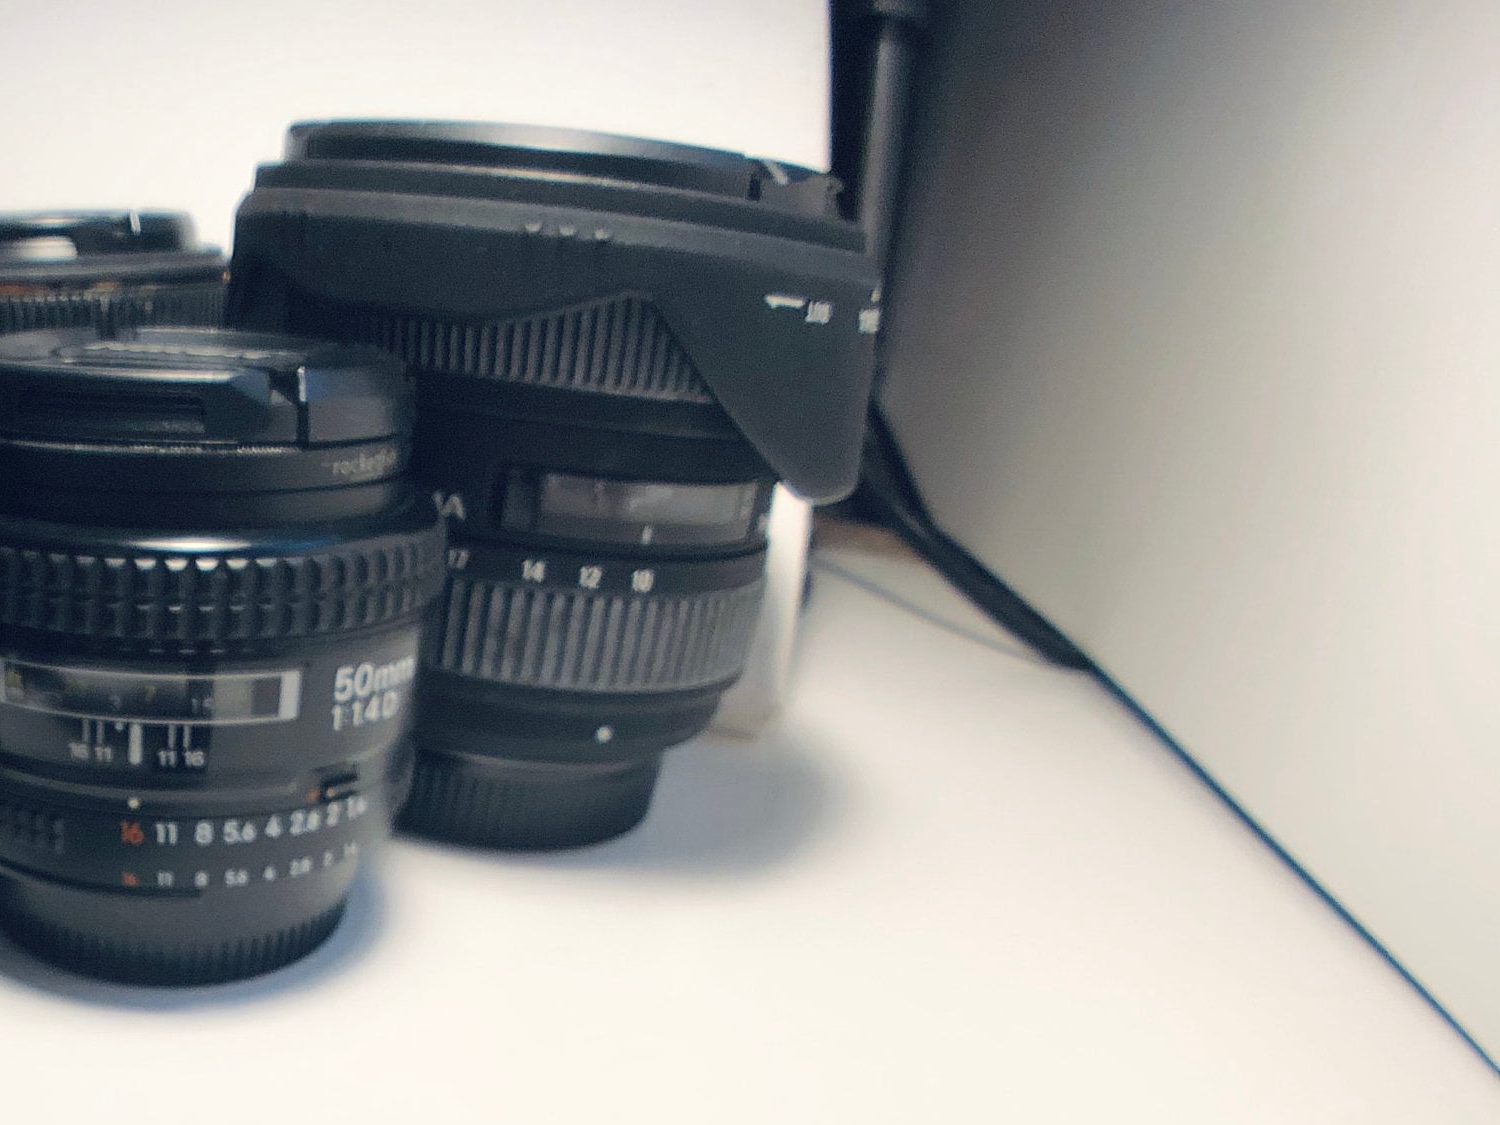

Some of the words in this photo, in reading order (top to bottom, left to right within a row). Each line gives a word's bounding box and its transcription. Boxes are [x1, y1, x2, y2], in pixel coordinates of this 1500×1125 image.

[522, 559, 546, 583] 14
[334, 656, 415, 701] 50mm
[120, 820, 145, 846] 16
[155, 821, 178, 846] 11
[195, 818, 214, 846] 8
[264, 813, 283, 838] 4
